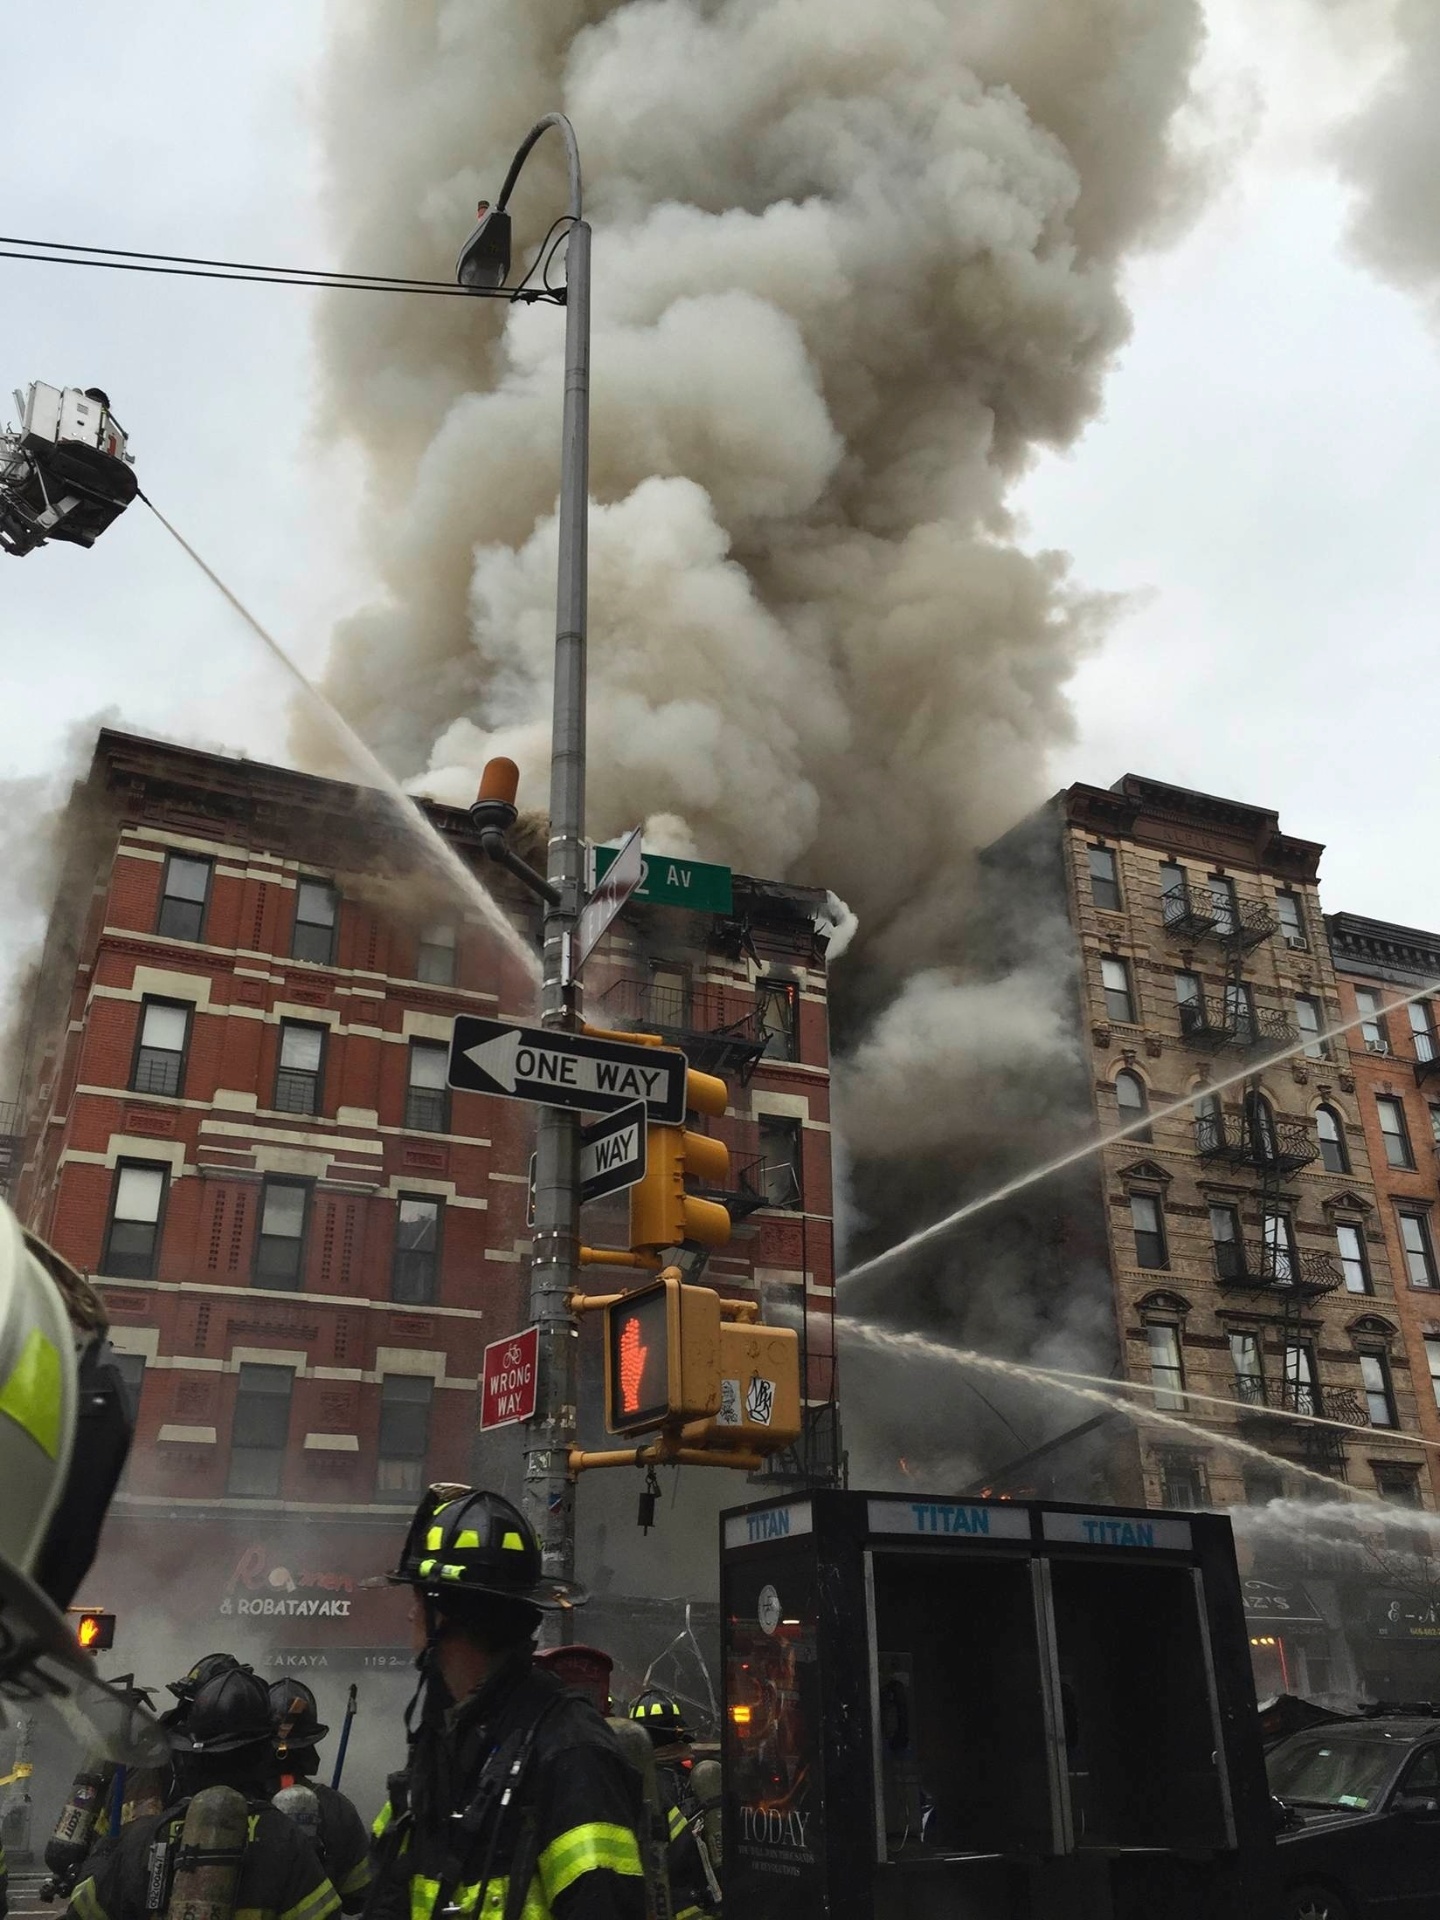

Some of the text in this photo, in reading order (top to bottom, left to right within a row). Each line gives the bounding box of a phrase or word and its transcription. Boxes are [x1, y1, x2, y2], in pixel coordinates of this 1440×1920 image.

[666, 864, 691, 887] Av
[515, 1049, 661, 1097] ONE WAY
[595, 1129, 634, 1172] WAY
[490, 1363, 531, 1396] WRONG
[498, 1391, 523, 1417] WAY
[746, 1508, 790, 1542] TITAN
[911, 1503, 990, 1535] TITAN
[1082, 1519, 1154, 1548] TITAN
[219, 1597, 351, 1617] & ROBATAYAKI
[740, 1806, 811, 1848] TODAY
